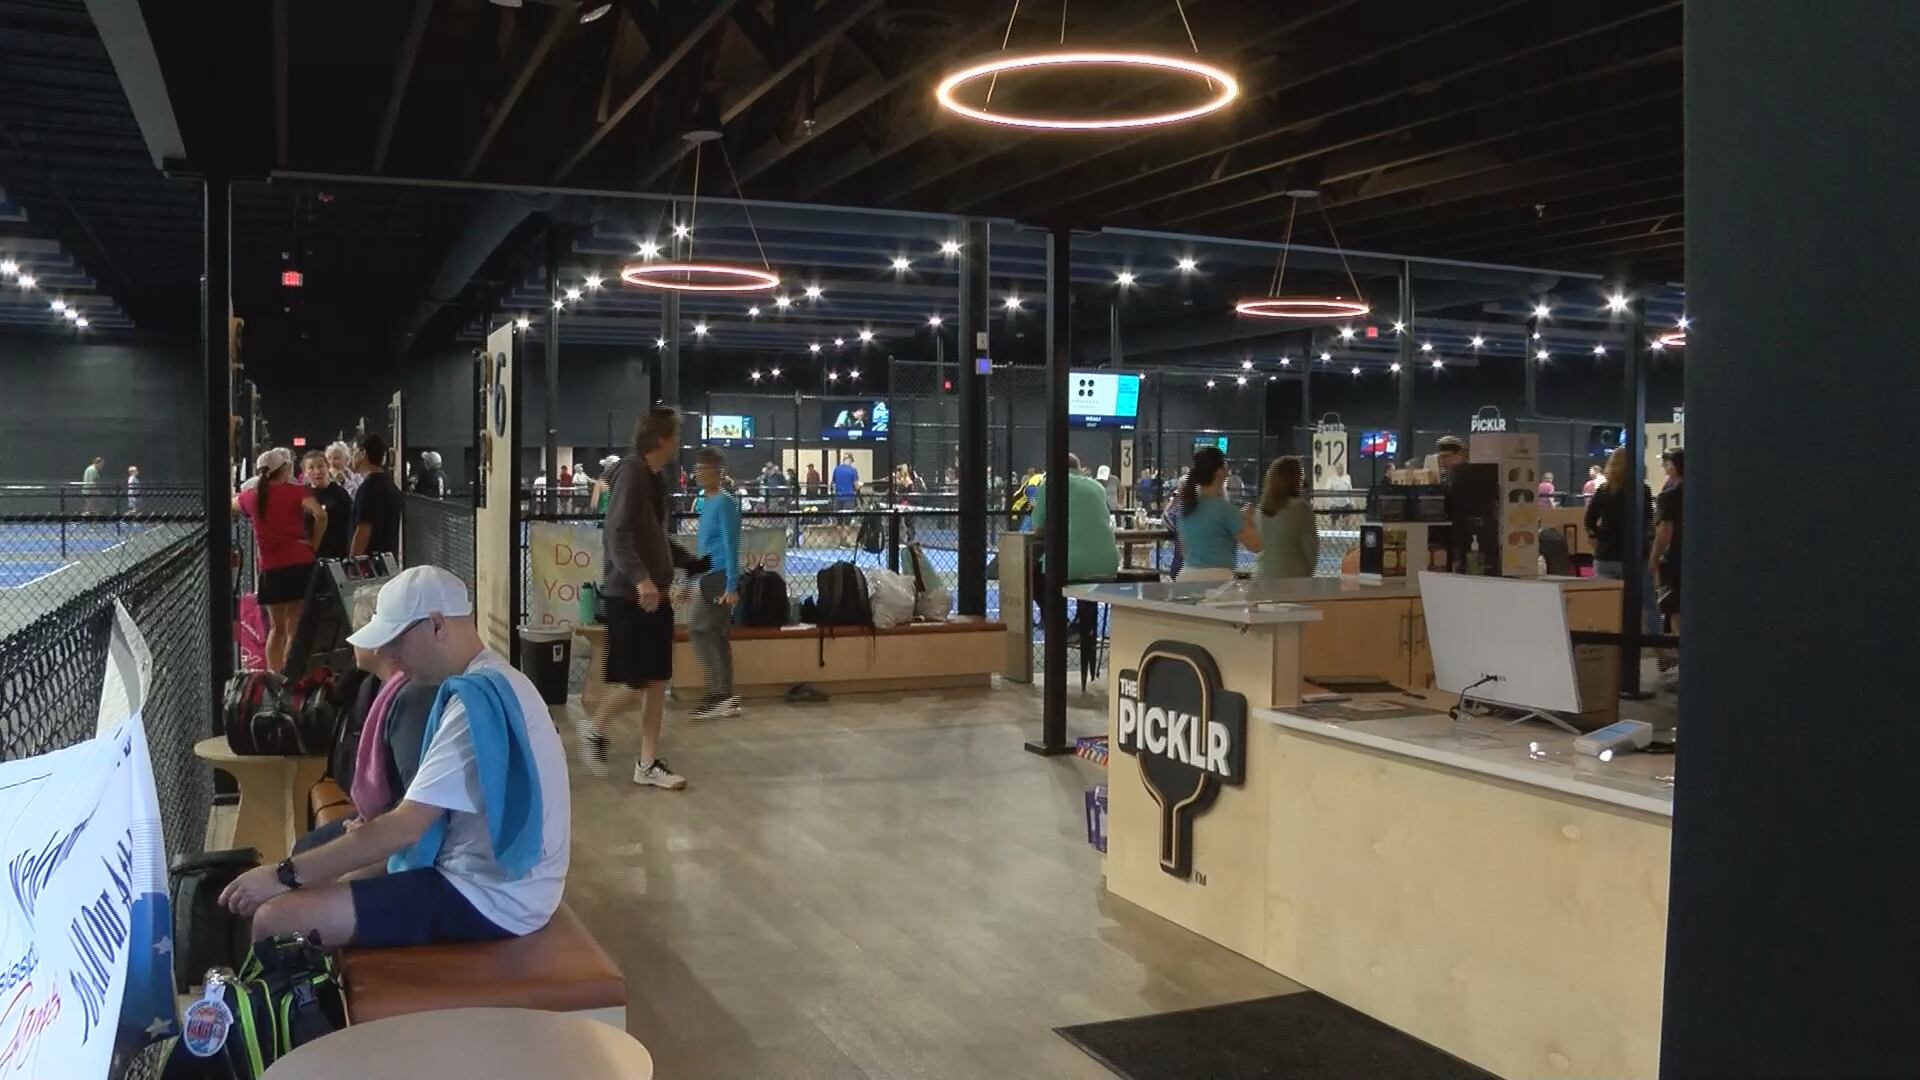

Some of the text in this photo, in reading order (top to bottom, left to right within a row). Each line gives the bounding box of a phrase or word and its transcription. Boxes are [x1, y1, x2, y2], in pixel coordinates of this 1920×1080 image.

[494, 352, 507, 438] 6
[1470, 418, 1507, 432] PICKLR
[1123, 446, 1132, 468] 3
[1325, 440, 1345, 466] 12
[555, 543, 591, 568] Do
[1120, 677, 1138, 698] THE
[1119, 697, 1231, 777] PICKLR
